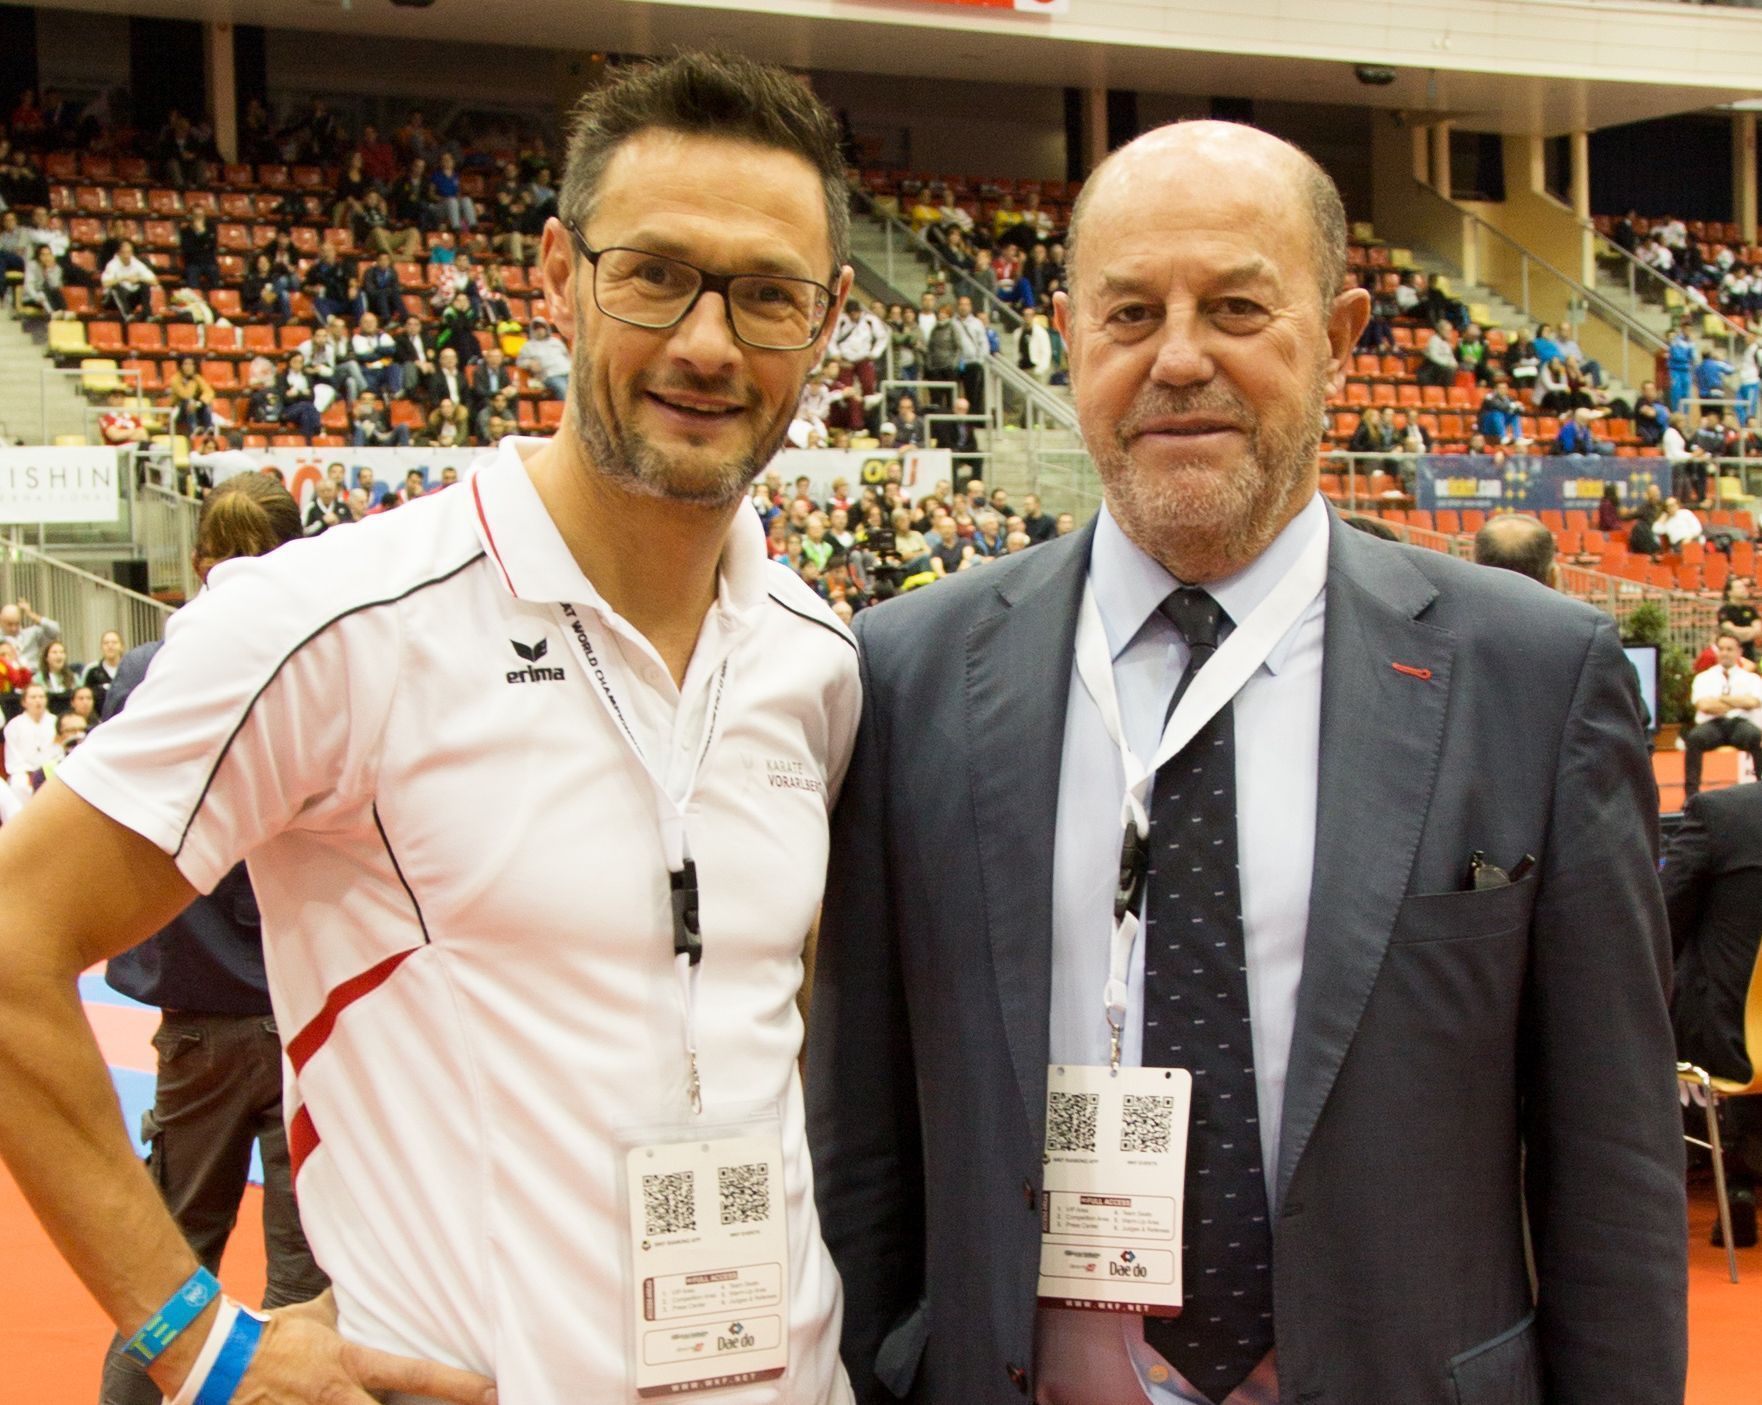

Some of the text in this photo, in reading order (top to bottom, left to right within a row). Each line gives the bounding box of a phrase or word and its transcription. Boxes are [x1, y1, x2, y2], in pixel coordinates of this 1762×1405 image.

[9, 466, 110, 489] ISHIN
[559, 602, 577, 617] AT
[571, 620, 598, 667] WORLD
[506, 665, 566, 684] erima
[766, 759, 804, 775] KARATE
[767, 774, 823, 793] VORARLBER
